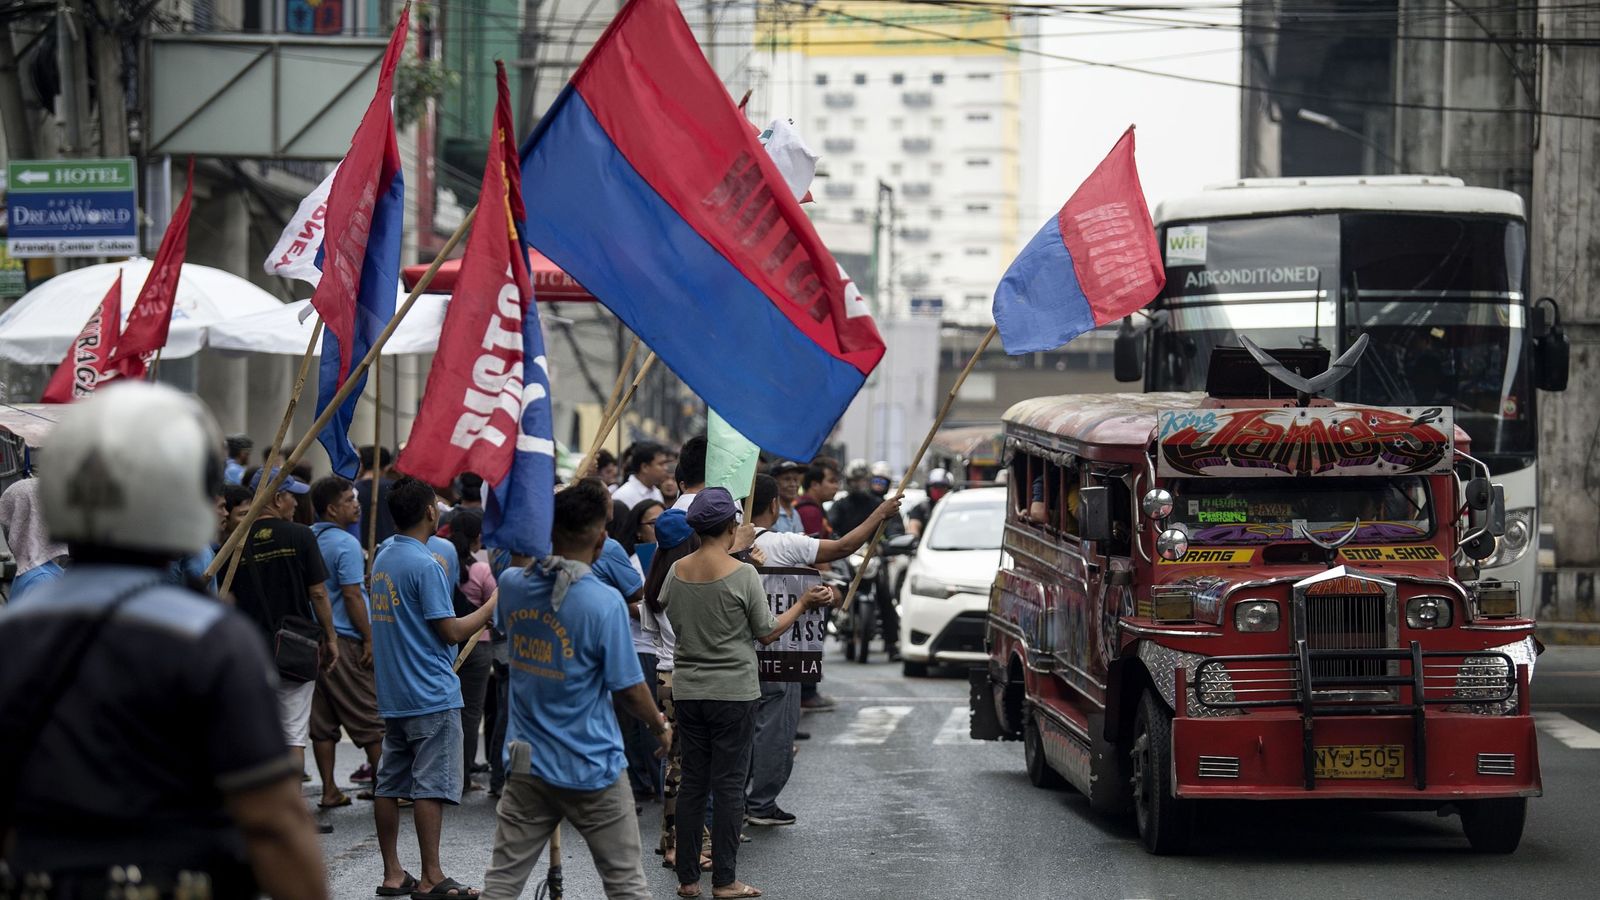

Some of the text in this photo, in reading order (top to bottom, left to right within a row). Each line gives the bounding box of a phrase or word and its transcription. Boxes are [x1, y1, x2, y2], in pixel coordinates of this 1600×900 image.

[55, 167, 125, 184] HOTEL
[1170, 236, 1205, 250] WiFi
[1184, 266, 1320, 289] AIRCONDITIONED
[450, 263, 524, 450] PISTO
[1160, 550, 1236, 562] RANG
[1342, 549, 1383, 560] STOP
[1394, 547, 1441, 560] SHOP
[1308, 577, 1382, 595] ARNOLD
